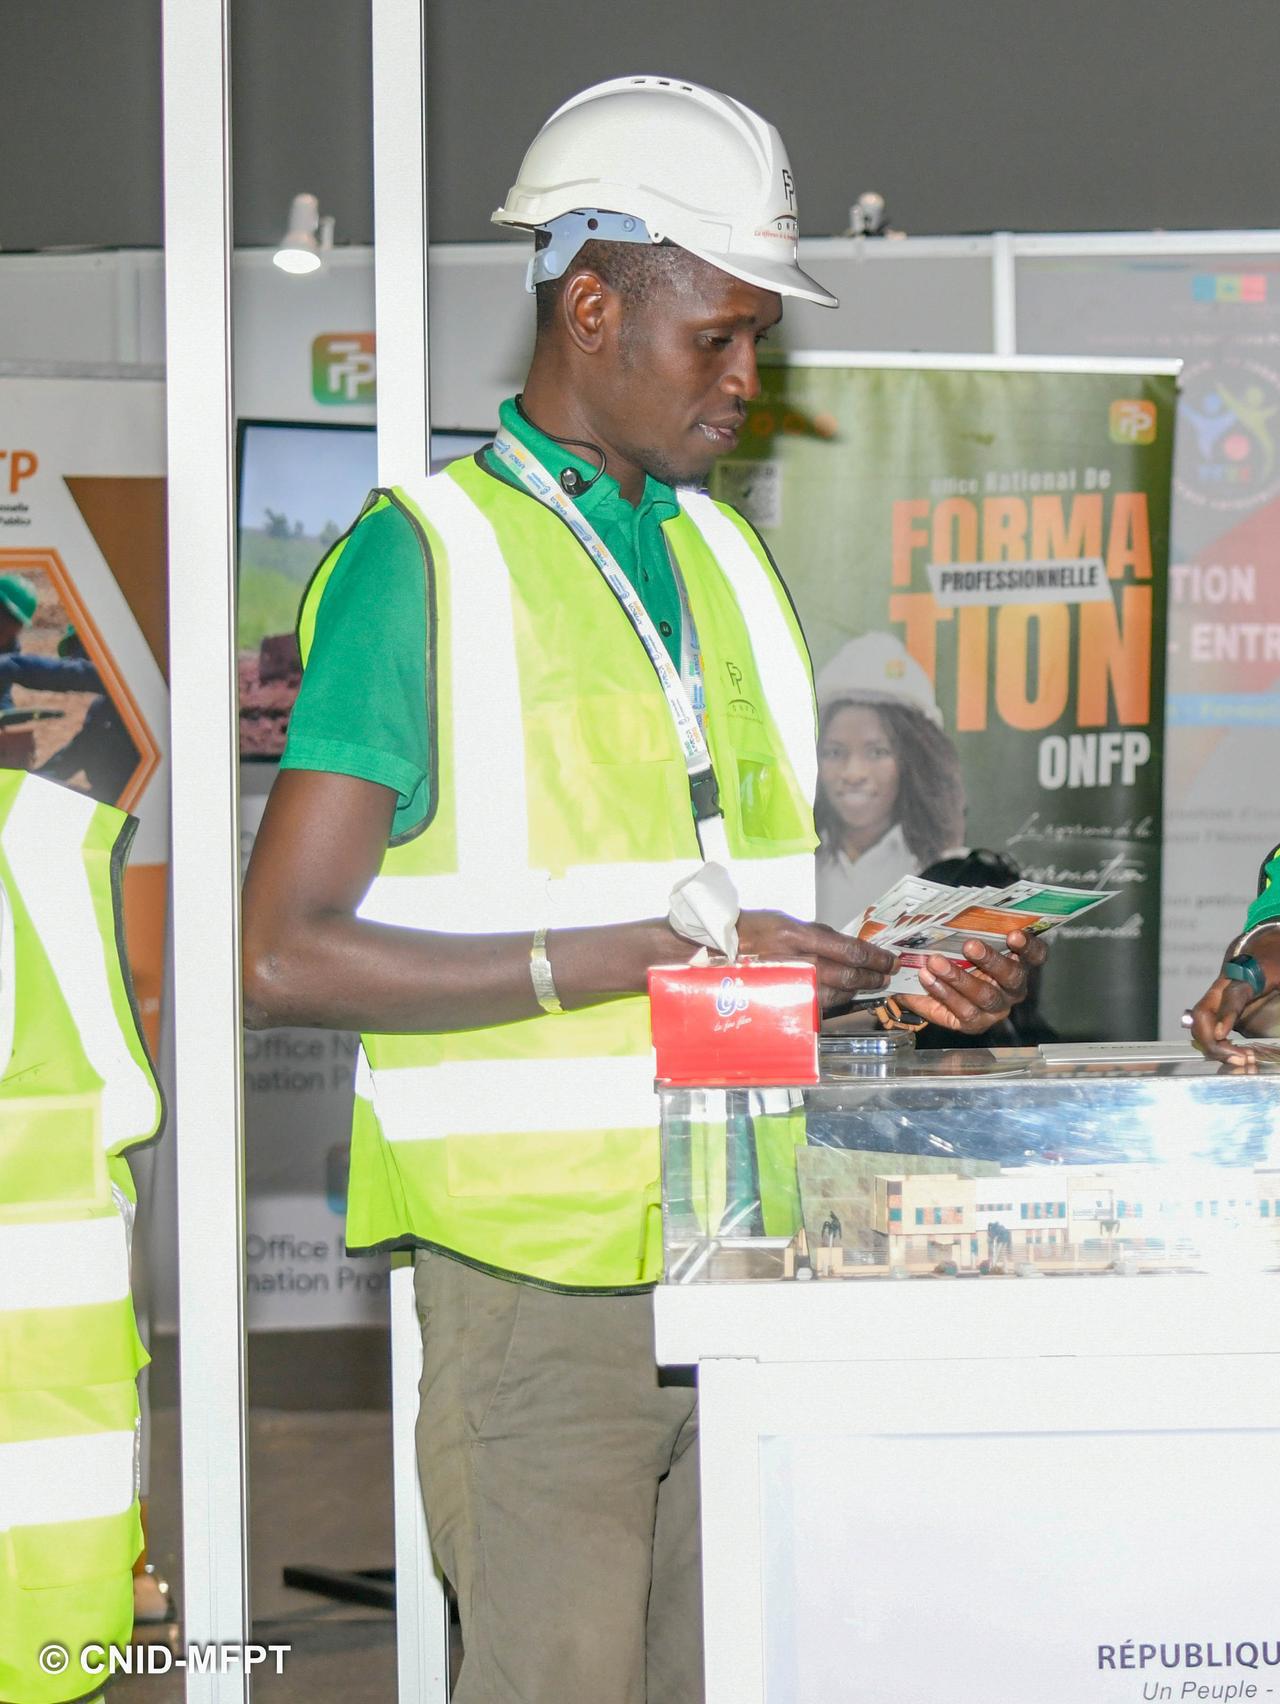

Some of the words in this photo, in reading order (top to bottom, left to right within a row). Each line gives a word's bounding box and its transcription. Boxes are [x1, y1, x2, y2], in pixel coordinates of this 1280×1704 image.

[0, 449, 39, 495] P
[984, 468, 1076, 493] National
[1084, 467, 1111, 490] De
[891, 491, 1153, 588] FORMA
[940, 566, 1099, 592] PROFESSIONNELLE
[1169, 563, 1256, 603] TION
[889, 584, 1153, 733] TION
[1038, 731, 1151, 790] ONFP
[247, 1232, 329, 1262] Office
[1143, 1681, 1171, 1701] Un
[1181, 1679, 1257, 1703] Peuple
